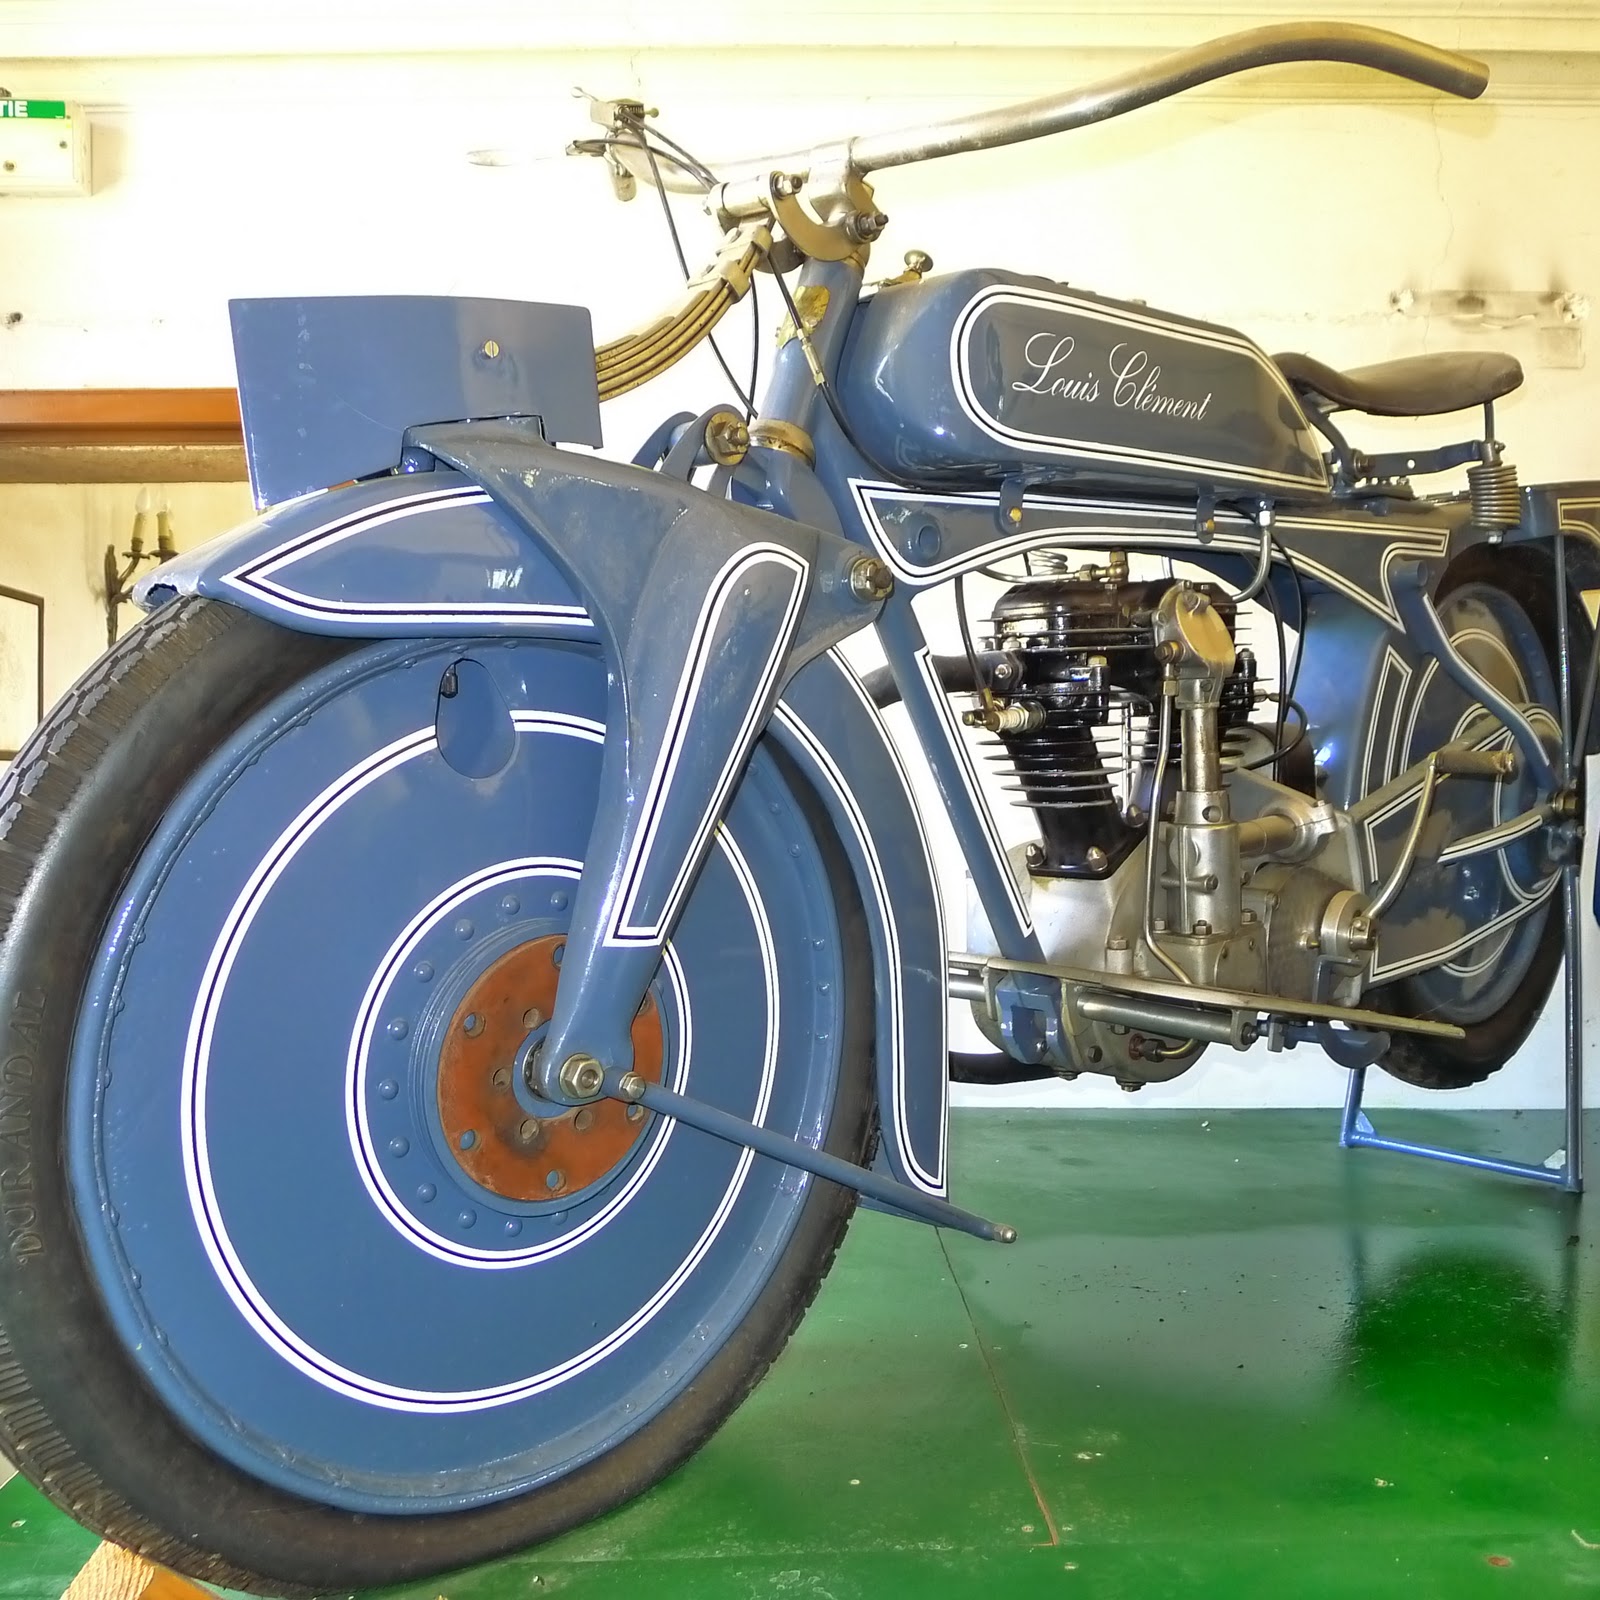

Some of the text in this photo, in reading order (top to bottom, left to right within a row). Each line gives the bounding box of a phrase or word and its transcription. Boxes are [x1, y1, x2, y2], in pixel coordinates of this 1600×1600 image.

[1011, 332, 1213, 421] Louis Clément
[0, 986, 47, 1257] DURANDAL
